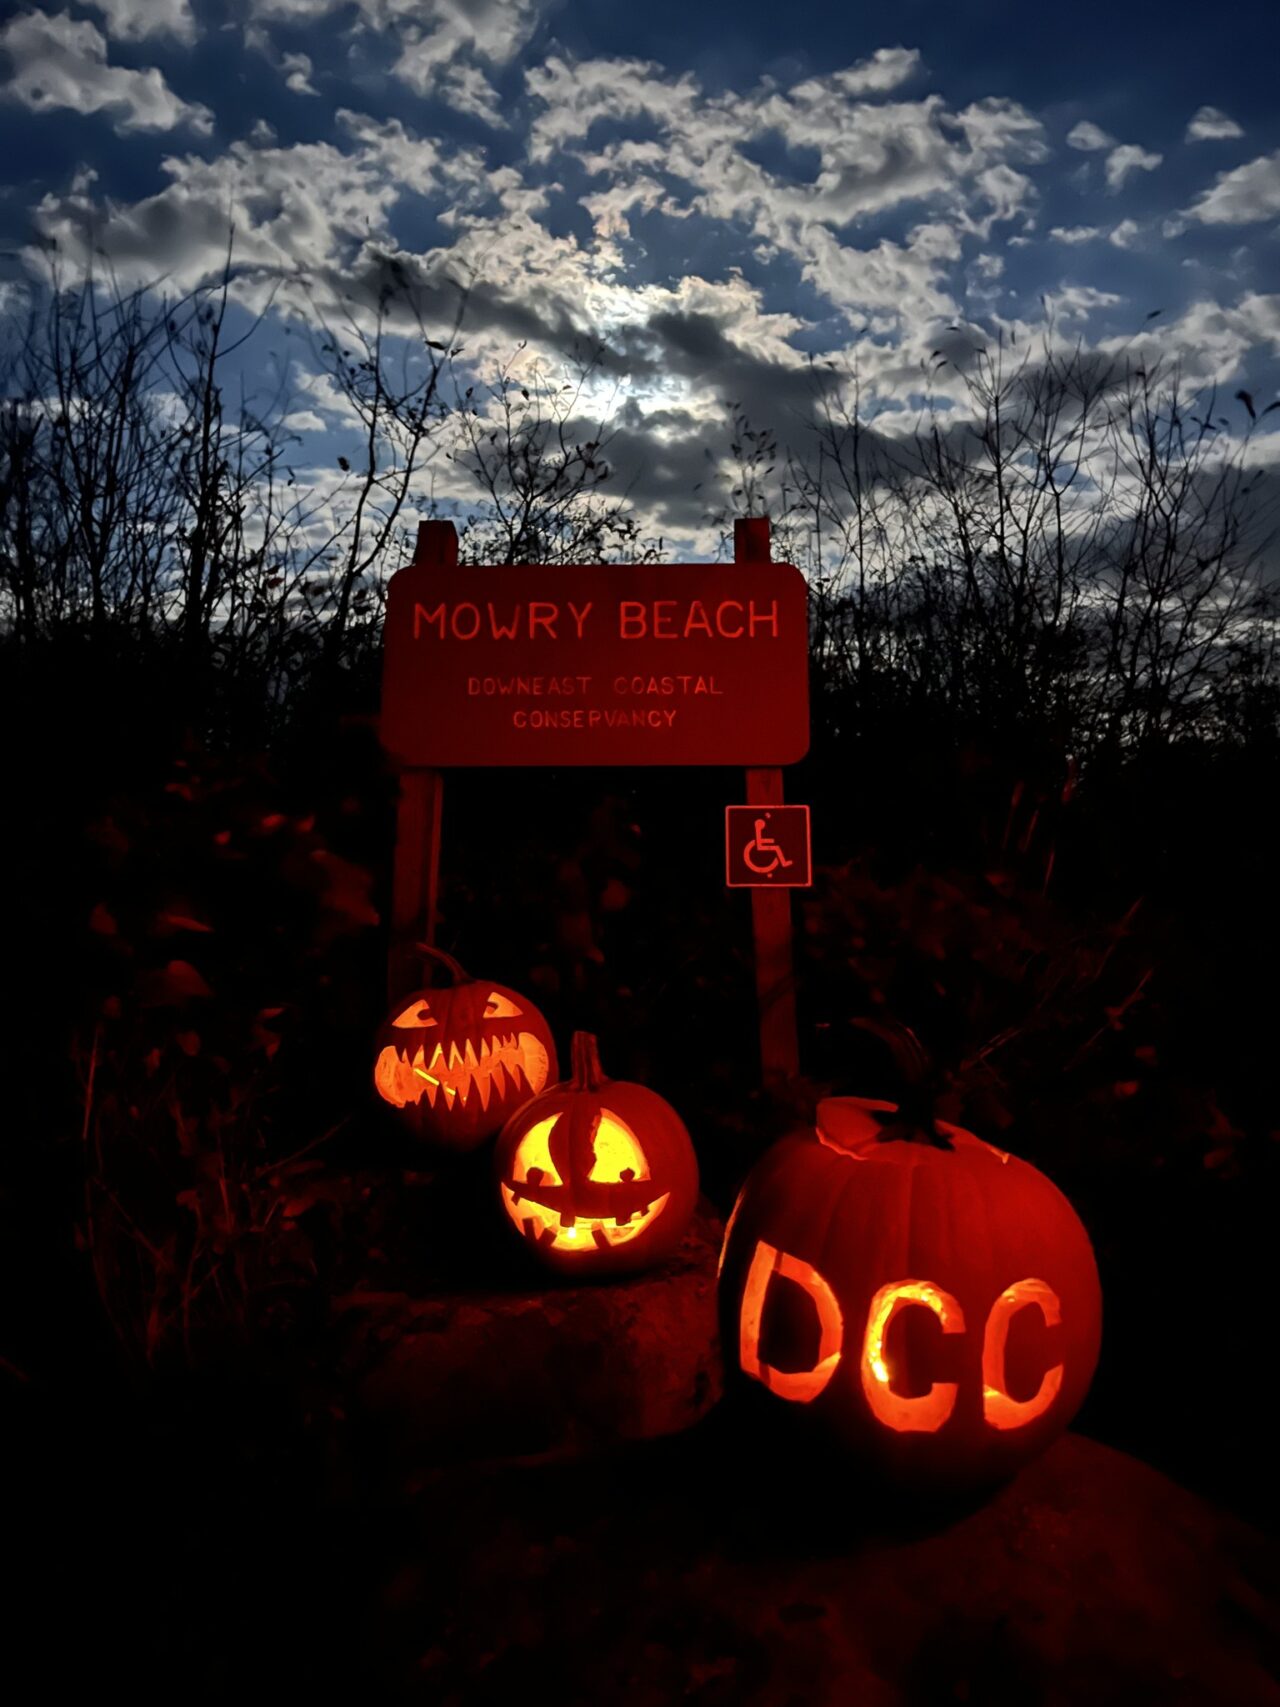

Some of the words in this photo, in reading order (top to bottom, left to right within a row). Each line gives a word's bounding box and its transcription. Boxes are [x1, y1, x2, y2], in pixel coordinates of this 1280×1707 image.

[413, 600, 593, 640] MOWRY
[619, 600, 779, 640] BEACH
[467, 676, 592, 696] DOWNEAST
[613, 675, 724, 696] COASTAL
[512, 709, 678, 729] CONSERVANCY
[740, 1240, 1064, 1433] DCC
